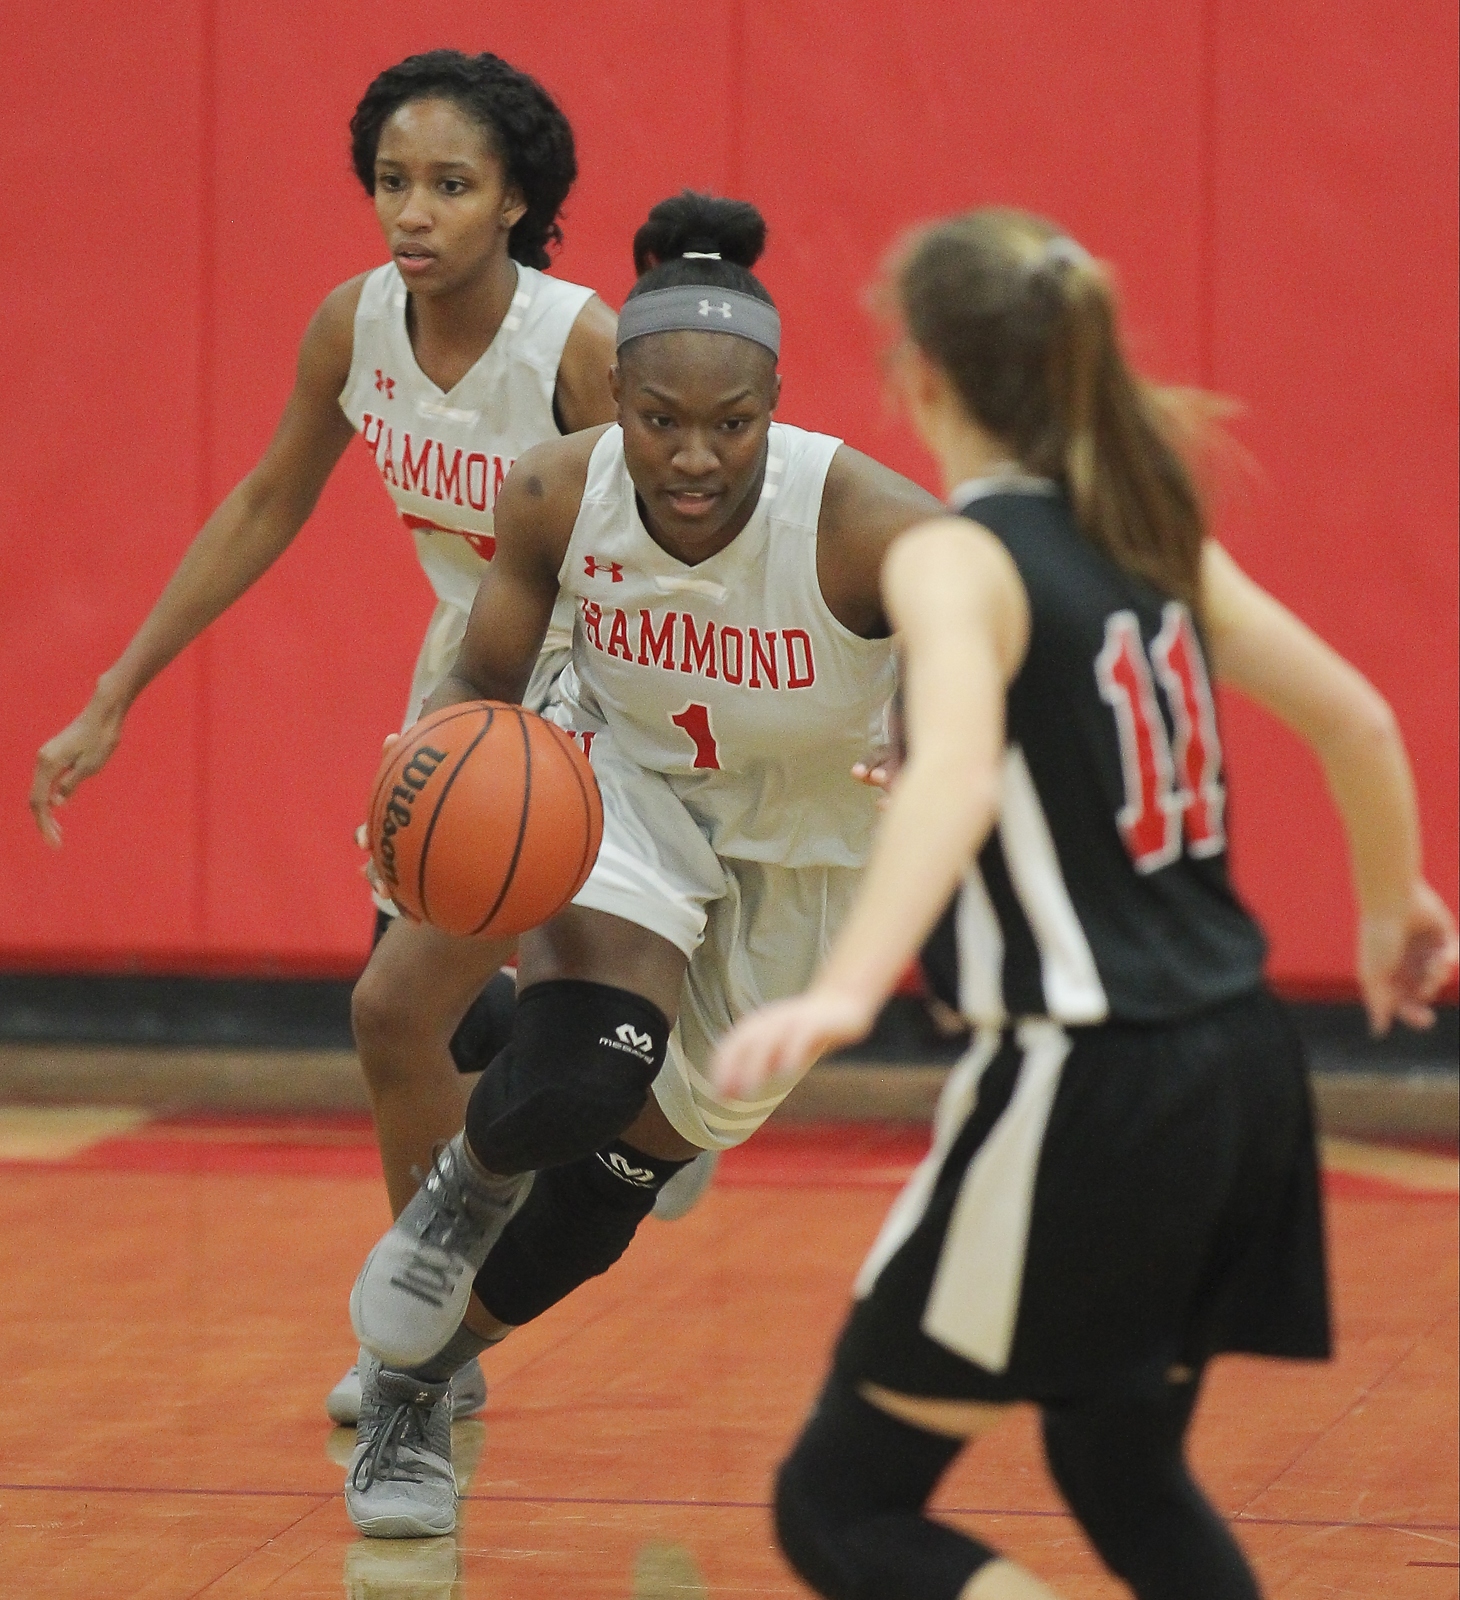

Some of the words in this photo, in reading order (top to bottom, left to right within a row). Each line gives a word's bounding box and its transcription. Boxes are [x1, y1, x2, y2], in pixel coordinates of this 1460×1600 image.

[576, 597, 816, 690] HAMMOND
[669, 701, 722, 770] 1
[1093, 601, 1226, 876] 11
[380, 745, 449, 886] Wilson
